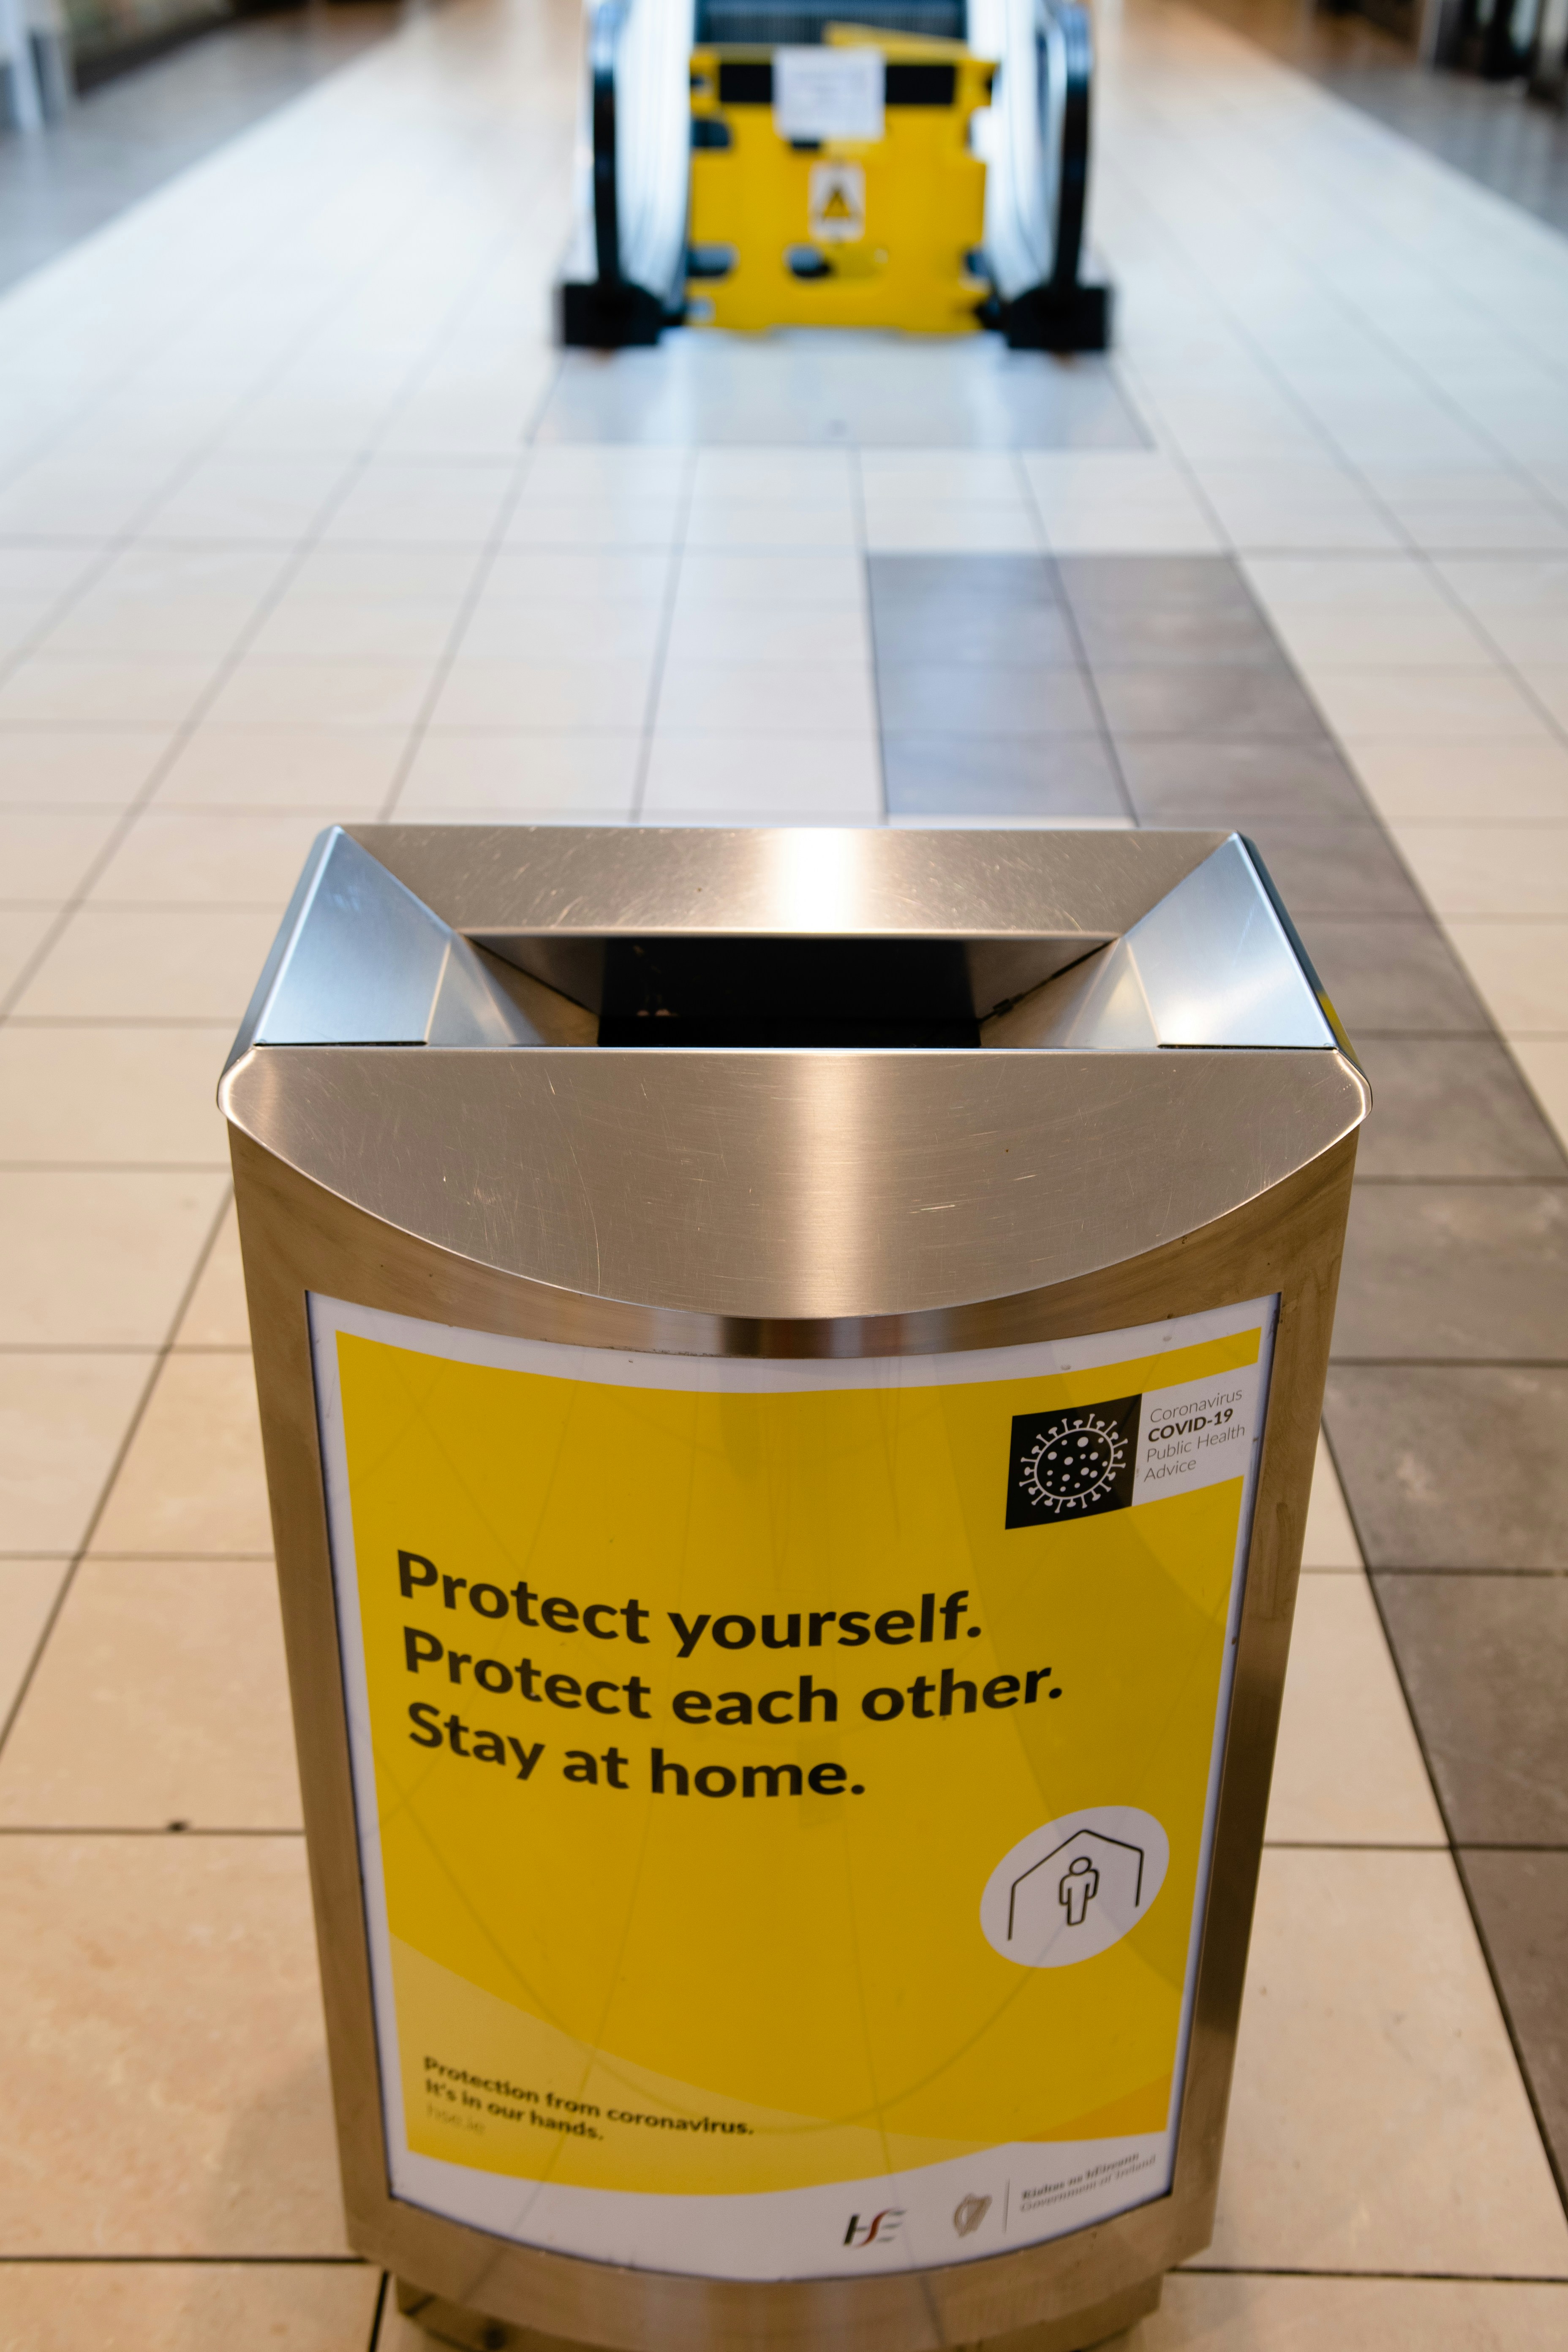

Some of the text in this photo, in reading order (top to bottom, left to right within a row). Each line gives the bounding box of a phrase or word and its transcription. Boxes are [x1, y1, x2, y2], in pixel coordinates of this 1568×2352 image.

[1148, 1408, 1234, 1442] COVID-19
[1150, 1389, 1243, 1423] Coronavirus
[1147, 1424, 1245, 1462] Public Health
[1143, 1459, 1197, 1482] Advice
[397, 1548, 982, 1658] Protect yourself.
[402, 1625, 1064, 1726] Protect each other.
[407, 1701, 866, 1798] Stay at home.
[424, 2055, 754, 2135] Protection from coronavirus.
[425, 2077, 604, 2141] It's in our hands.
[1020, 2181, 1096, 2212] Government
[1099, 2174, 1112, 2187] of
[844, 2206, 907, 2250] HSE
